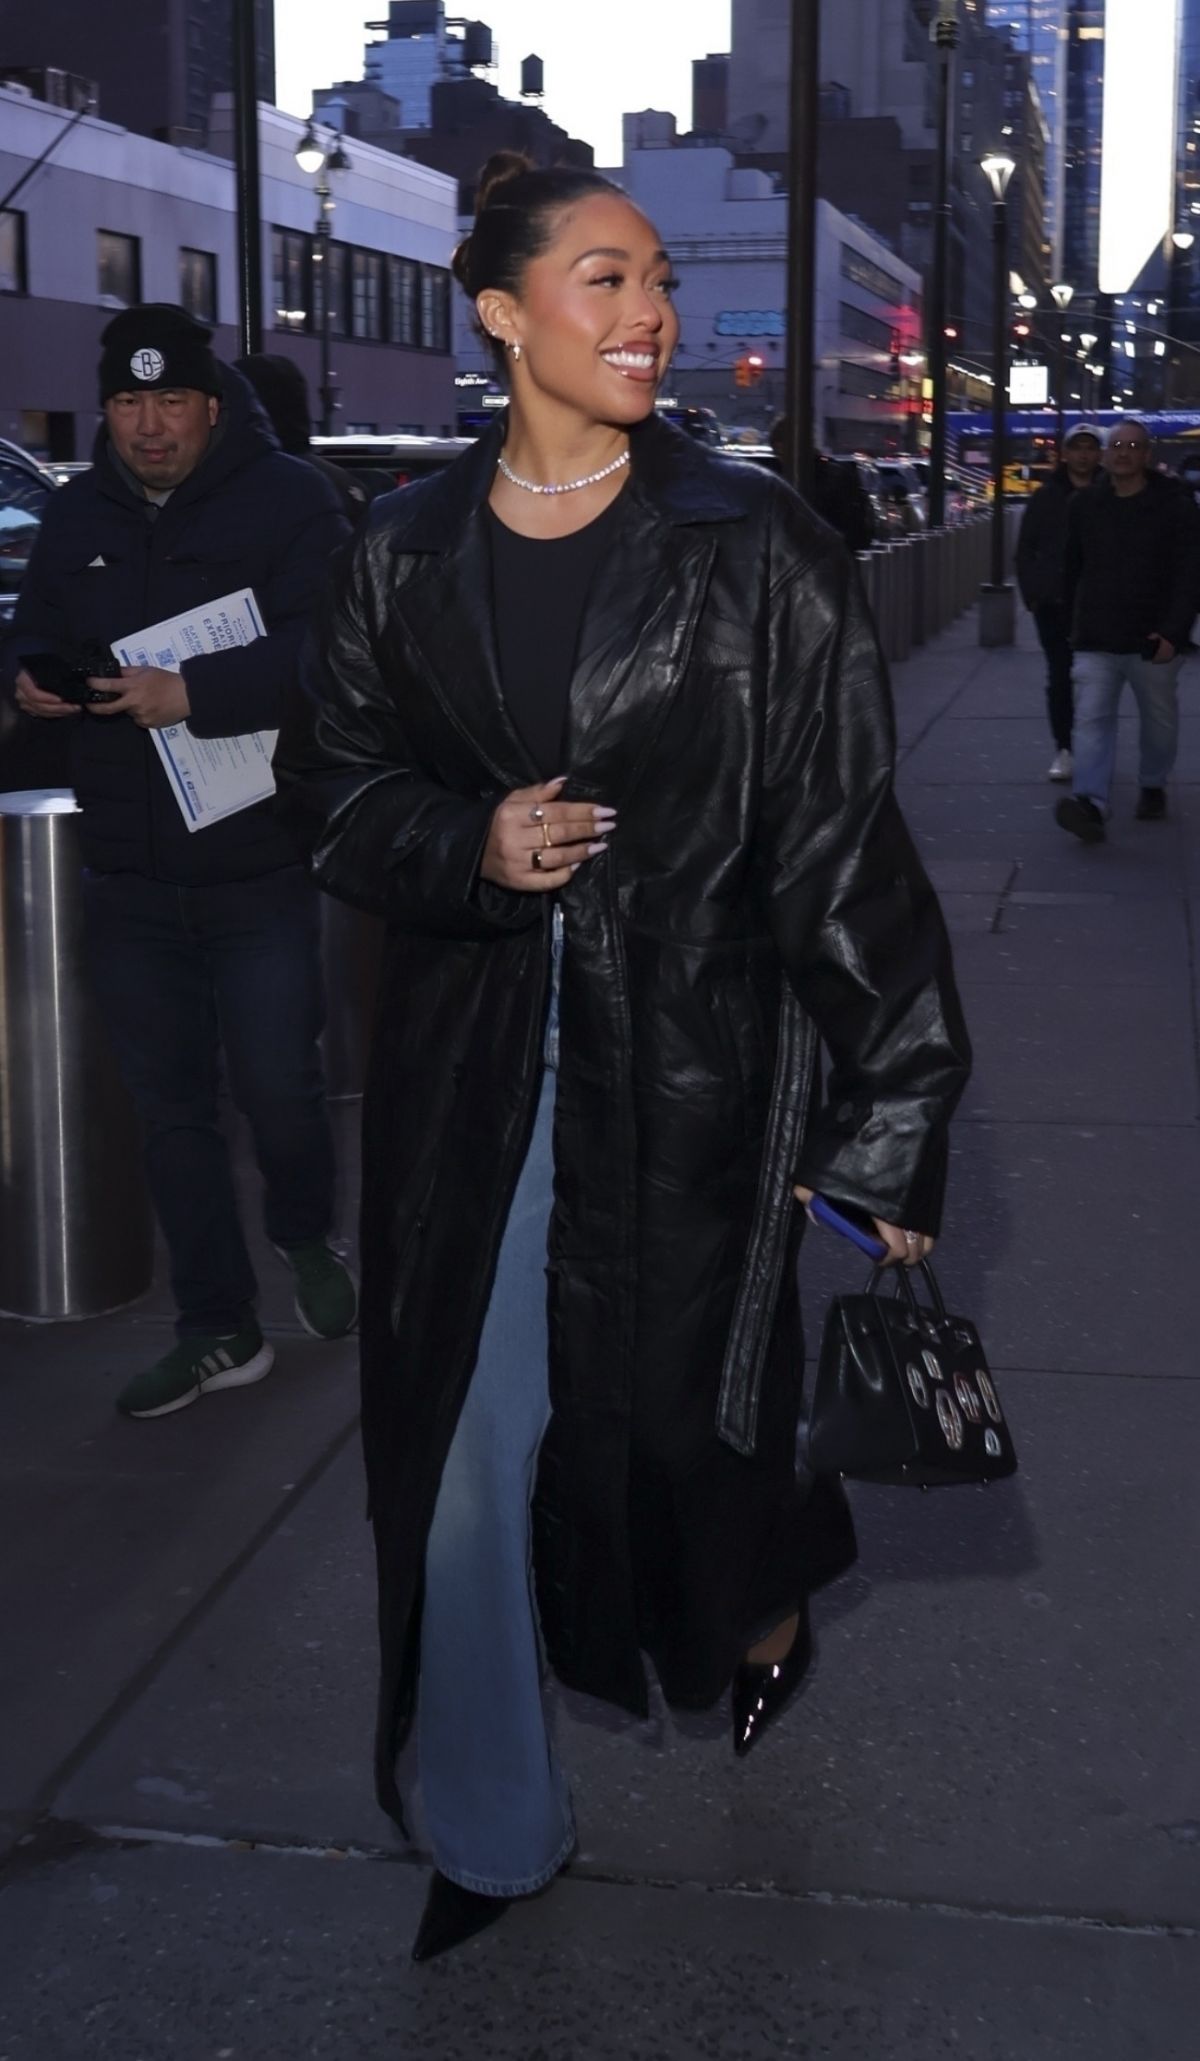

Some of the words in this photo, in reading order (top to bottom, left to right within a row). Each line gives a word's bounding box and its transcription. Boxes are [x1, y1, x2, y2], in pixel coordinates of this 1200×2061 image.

[141, 352, 154, 377] B
[182, 627, 199, 656] ENVELOP
[203, 618, 222, 650] EXPRE
[216, 625, 229, 649] MAIL
[218, 612, 237, 646] PRIORI
